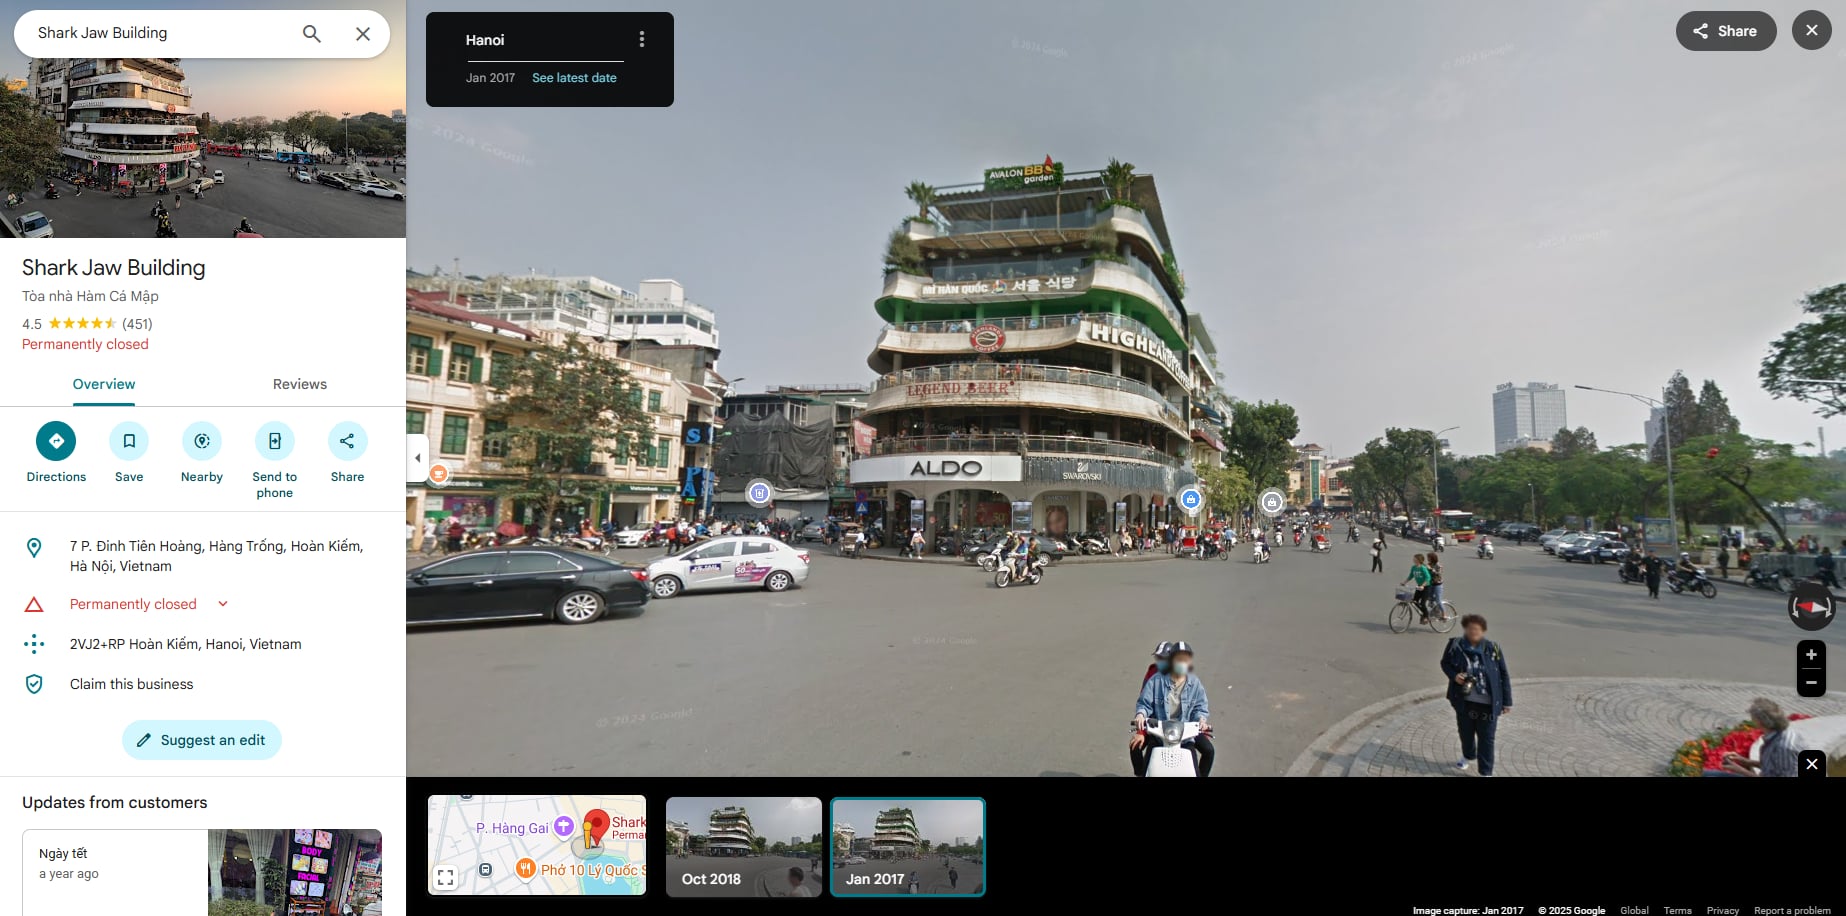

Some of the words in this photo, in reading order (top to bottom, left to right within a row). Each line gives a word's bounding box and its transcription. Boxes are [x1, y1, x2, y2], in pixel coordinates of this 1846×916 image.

[38, 26, 78, 39] Shark
[81, 27, 108, 39] Jaw
[113, 26, 167, 42] Building
[1718, 25, 1757, 37] Share
[466, 34, 504, 46] Hanoi
[466, 73, 486, 84] Jan
[490, 73, 515, 84] 2017
[532, 73, 554, 84] See
[557, 72, 589, 84] latest
[592, 72, 617, 84] date
[990, 168, 1023, 179] AVALON
[1024, 175, 1054, 184] garden
[22, 259, 78, 276] Shark
[82, 259, 122, 276] Jaw
[128, 259, 205, 280] Building
[22, 290, 45, 302] Tòa
[49, 290, 72, 302] nhà
[77, 290, 105, 302] Hàm
[110, 290, 126, 302] Cá
[131, 290, 159, 305] Mập
[22, 319, 42, 330] 4.5
[123, 318, 152, 332] (451)
[22, 338, 102, 353] Permanently
[107, 338, 149, 350] closed
[73, 378, 135, 390] Overview
[273, 378, 327, 390] Reviews
[908, 382, 960, 398] LEGEND
[967, 382, 1009, 396] BEER
[910, 460, 983, 477] ALDO
[27, 472, 86, 482] Directions
[115, 472, 143, 483] Save
[181, 471, 223, 485] Nearby
[252, 471, 281, 483] Send
[285, 473, 297, 483] to
[331, 471, 364, 482] Share
[1062, 472, 1102, 481] SWAROVSKI
[257, 487, 293, 500] phone
[70, 541, 77, 551] 7
[81, 541, 92, 551] P.
[96, 540, 125, 551] Đinh
[128, 540, 156, 552] Tiên
[160, 540, 205, 555] Hoàng,
[209, 540, 242, 555] Hàng
[246, 538, 287, 555] Trống,
[291, 540, 324, 552] Hoàn
[329, 538, 363, 554] Kiếm,
[70, 560, 87, 572] Hà
[92, 560, 116, 574] Nội,
[120, 560, 171, 572] Vietnam
[70, 597, 150, 612] Permanently
[154, 598, 196, 610] closed
[70, 638, 125, 650] 2VJ2+RP
[130, 638, 163, 650] Hoàn
[167, 636, 202, 652] Kiếm,
[206, 638, 246, 652] Hanoi,
[249, 637, 301, 650] Vietnam
[70, 678, 106, 690] Claim
[110, 677, 133, 690] this
[137, 678, 194, 690] business
[161, 734, 215, 749] Suggest
[219, 737, 235, 747] an
[240, 733, 266, 747] edit
[23, 795, 85, 812] Updates
[89, 795, 124, 809] from
[129, 797, 207, 809] customers
[612, 816, 646, 828] Shark
[476, 823, 488, 833] P.
[493, 822, 525, 836] Hàng
[529, 822, 549, 834] Gai
[40, 848, 69, 862] Ngày
[72, 847, 88, 859] tết
[301, 846, 322, 857] BODY
[39, 871, 46, 879] a
[49, 871, 74, 882] year
[77, 871, 99, 882] ago
[541, 864, 565, 876] Phở
[570, 865, 584, 876] 10
[588, 864, 602, 878] Lý
[605, 863, 638, 877] Quốc
[297, 872, 320, 882] FACIAL
[682, 874, 706, 885] Oct
[711, 874, 741, 885] 2018
[846, 874, 870, 885] Jan
[875, 874, 905, 885] 2017
[1413, 907, 1442, 916] Image
[1443, 907, 1480, 916] capture:
[1482, 907, 1499, 915] Jan
[1501, 907, 1525, 915] 2017
[1549, 907, 1572, 915] 2025
[1574, 906, 1606, 916] Google
[1620, 906, 1649, 915] Global
[1664, 906, 1692, 915] Terms
[1707, 906, 1740, 916] Privacy
[1754, 907, 1785, 916] Report
[1795, 906, 1832, 916] problem
